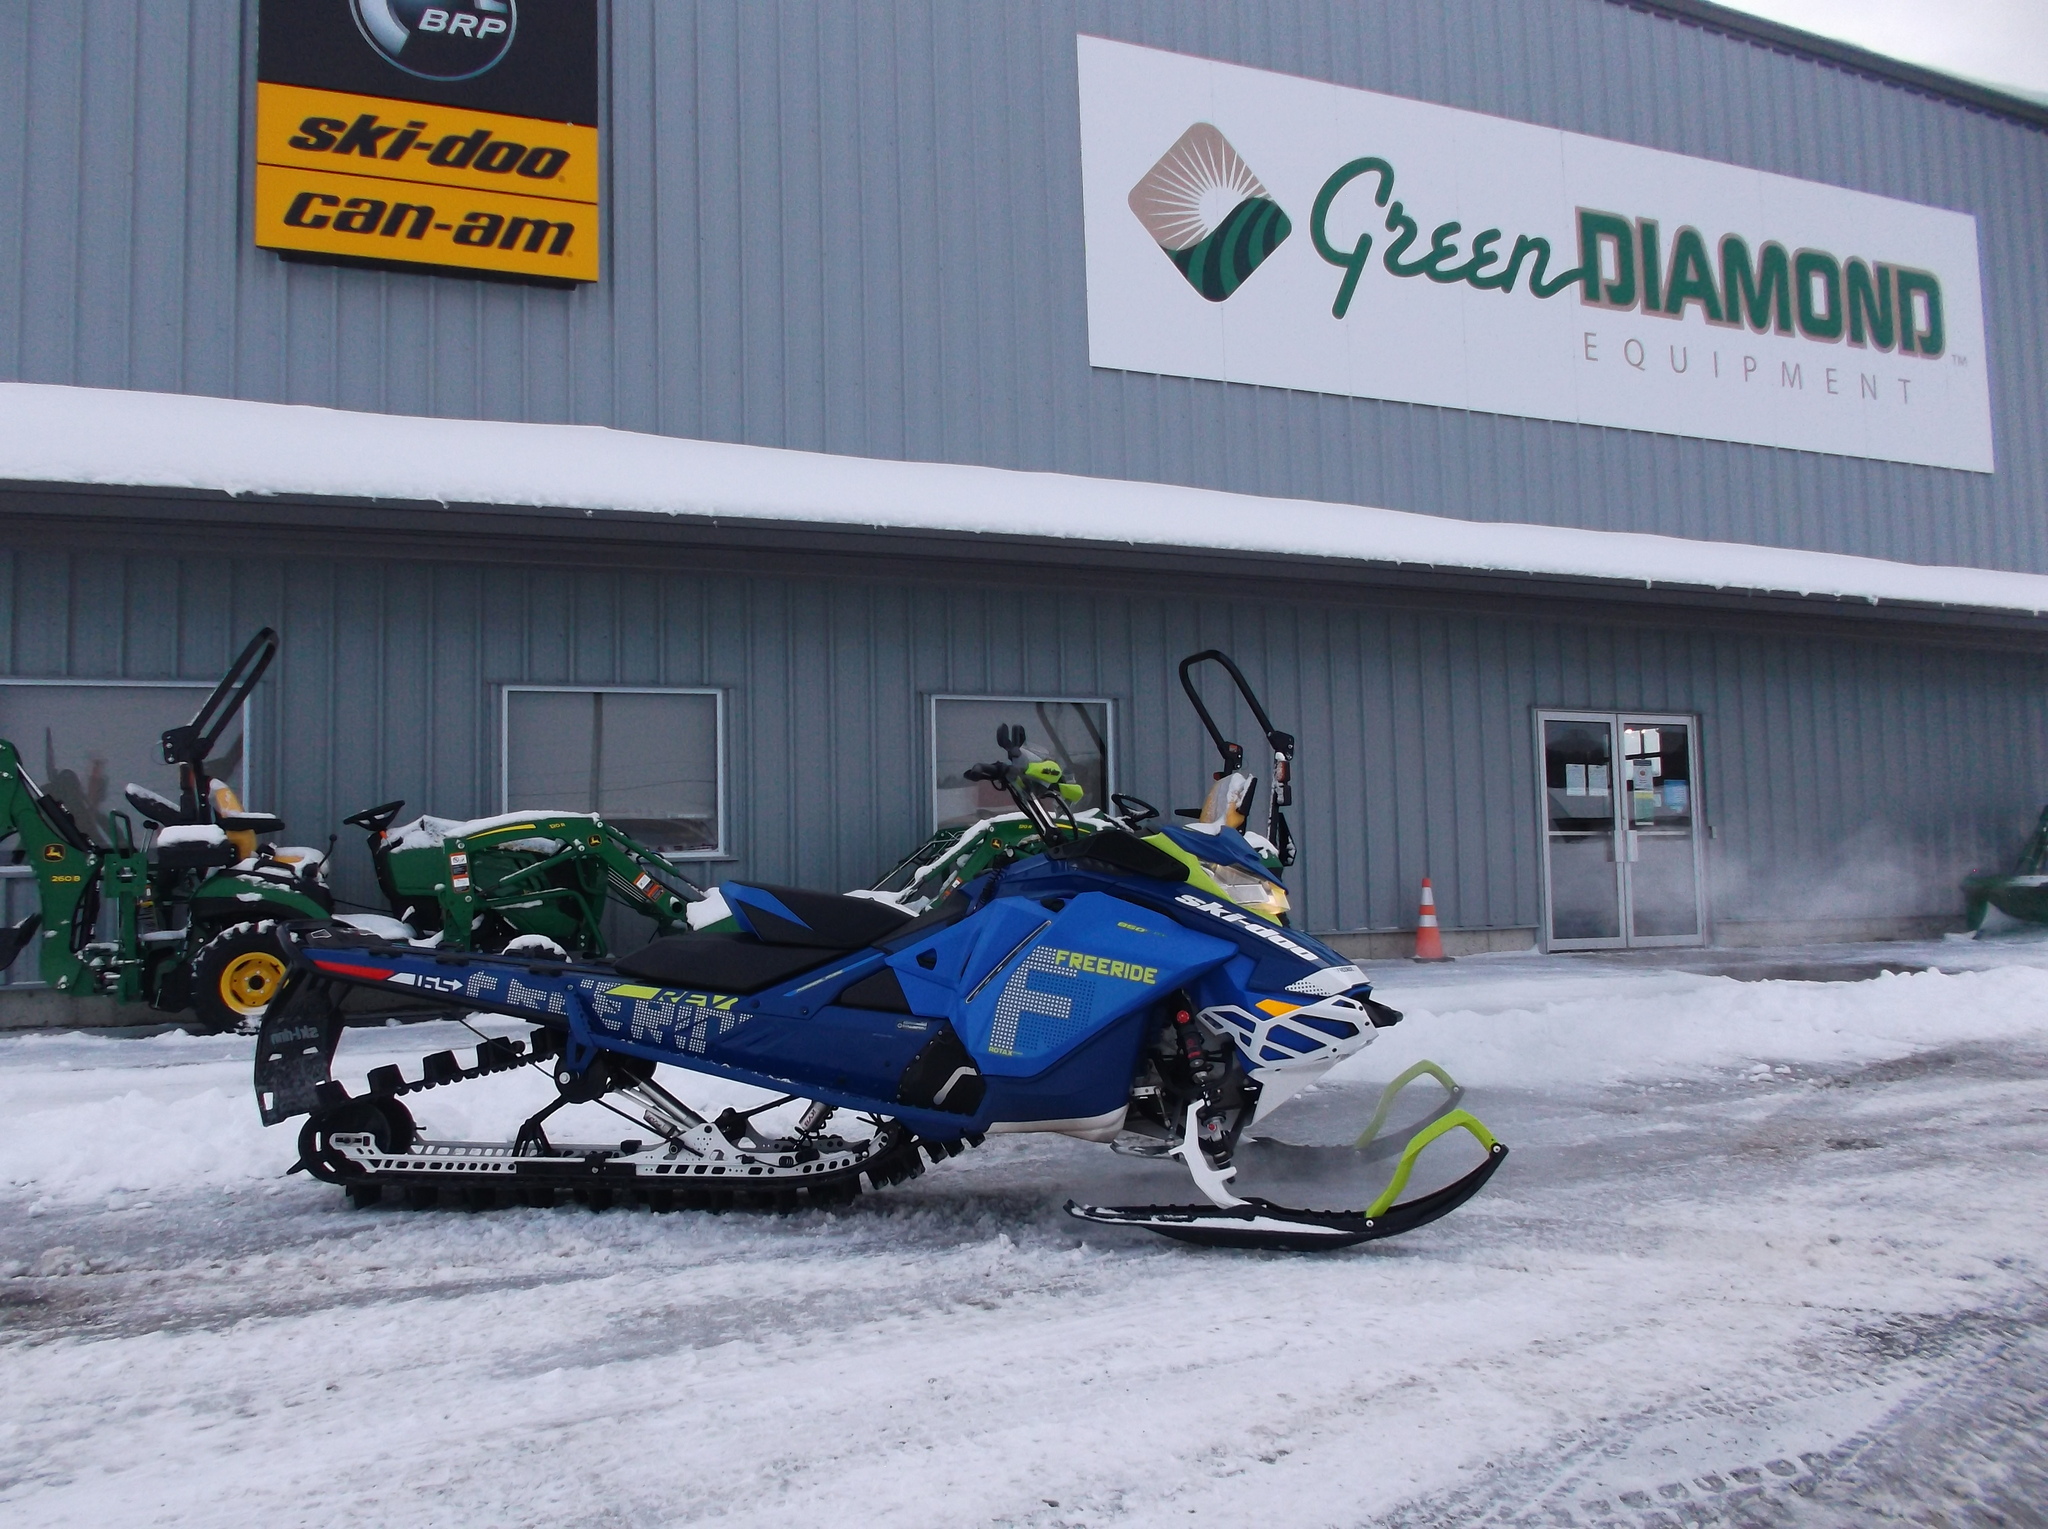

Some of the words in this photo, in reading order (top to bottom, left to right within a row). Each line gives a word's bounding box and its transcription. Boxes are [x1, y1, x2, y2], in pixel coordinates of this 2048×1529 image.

[418, 8, 507, 39] BRP
[288, 114, 571, 180] ski-doo
[283, 191, 575, 257] can-am
[1309, 156, 1585, 320] Green
[1574, 206, 1946, 360] DIAMOND
[1583, 331, 1912, 405] EQUIPMENT
[1174, 894, 1319, 961] ski-doo
[1055, 949, 1158, 985] FREERIDE
[989, 1046, 1013, 1057] ROTAX
